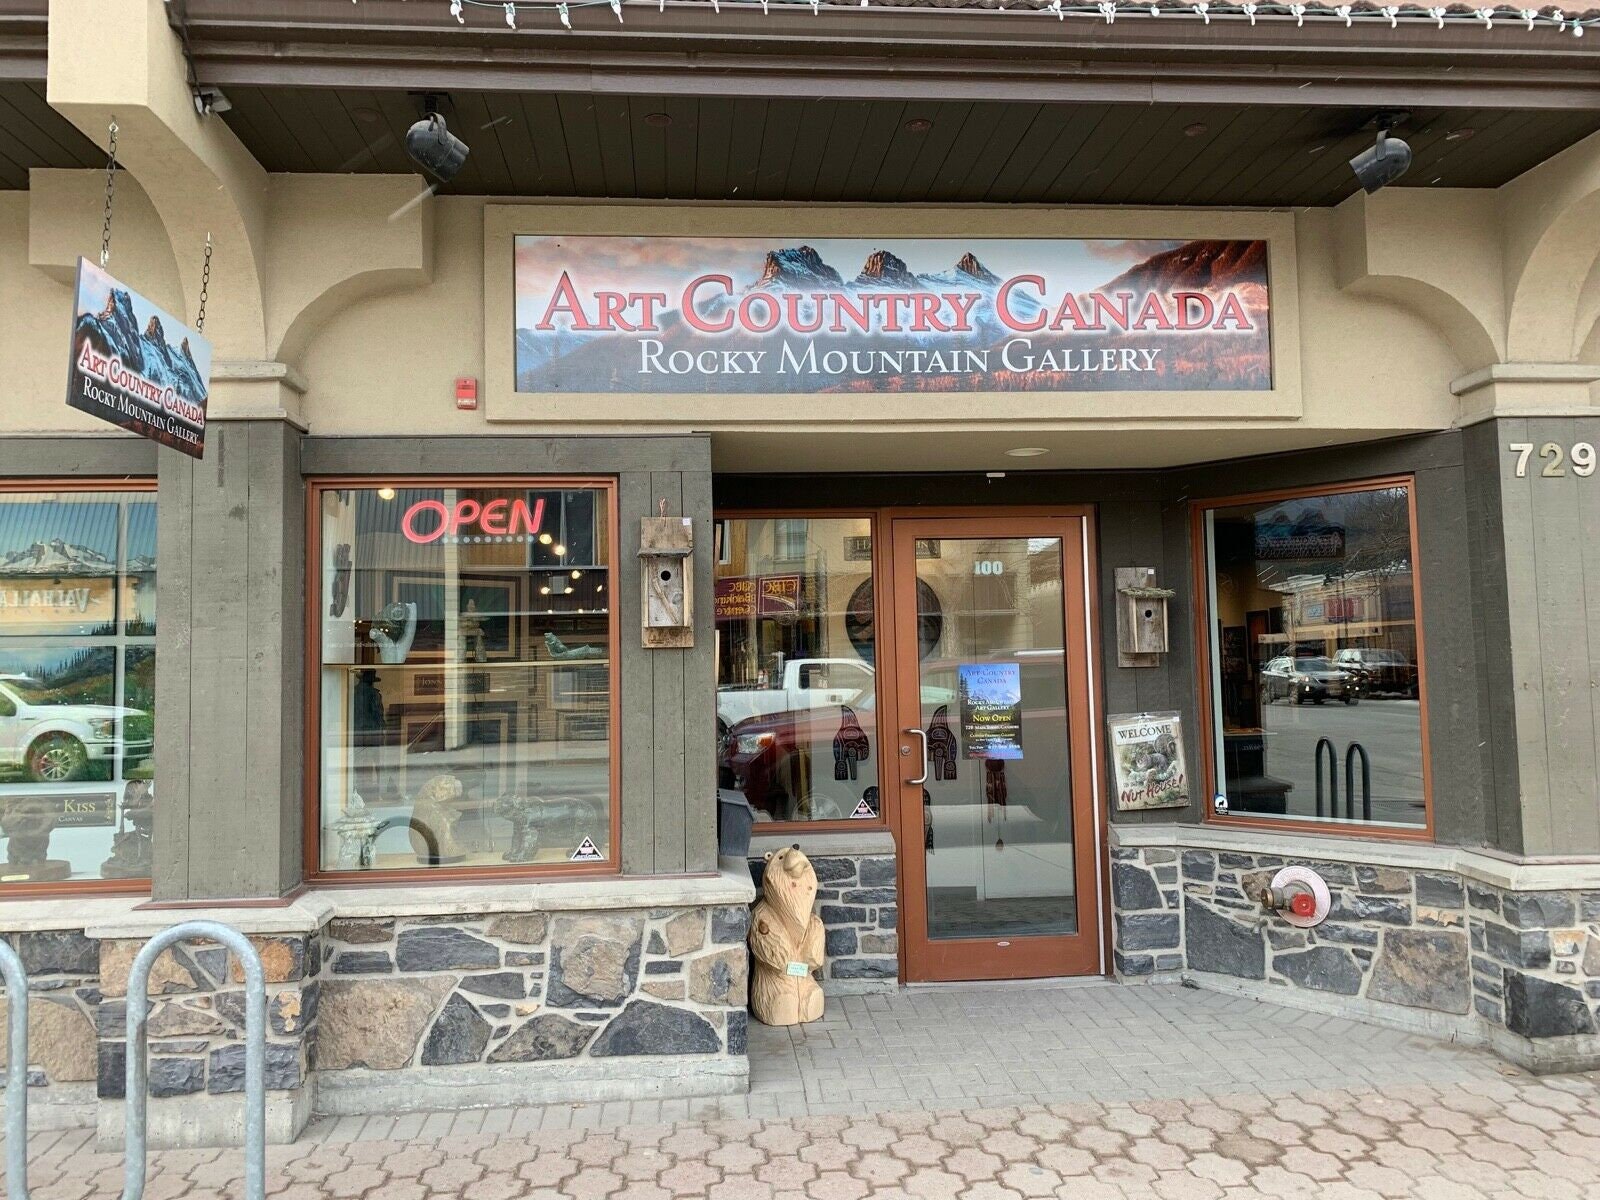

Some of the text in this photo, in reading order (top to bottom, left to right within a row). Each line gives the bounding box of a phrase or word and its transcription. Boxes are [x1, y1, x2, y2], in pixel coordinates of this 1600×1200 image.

[535, 270, 1253, 332] ART COUNTRY CANADA
[638, 338, 1161, 374] ROCKY MOUNTAIN GALLERY
[80, 342, 204, 426] ART COUNTRY CANADA
[83, 376, 199, 445] ROCKY MOUNTAIN GALLERY
[1509, 442, 1596, 477] 729
[402, 498, 545, 543] OPEN
[974, 560, 1004, 575] 100
[973, 714, 1011, 722] NOW OPEN
[1118, 724, 1172, 740] WELCOME
[1121, 773, 1184, 803] NUT HOUSE!
[64, 799, 96, 813] KISS
